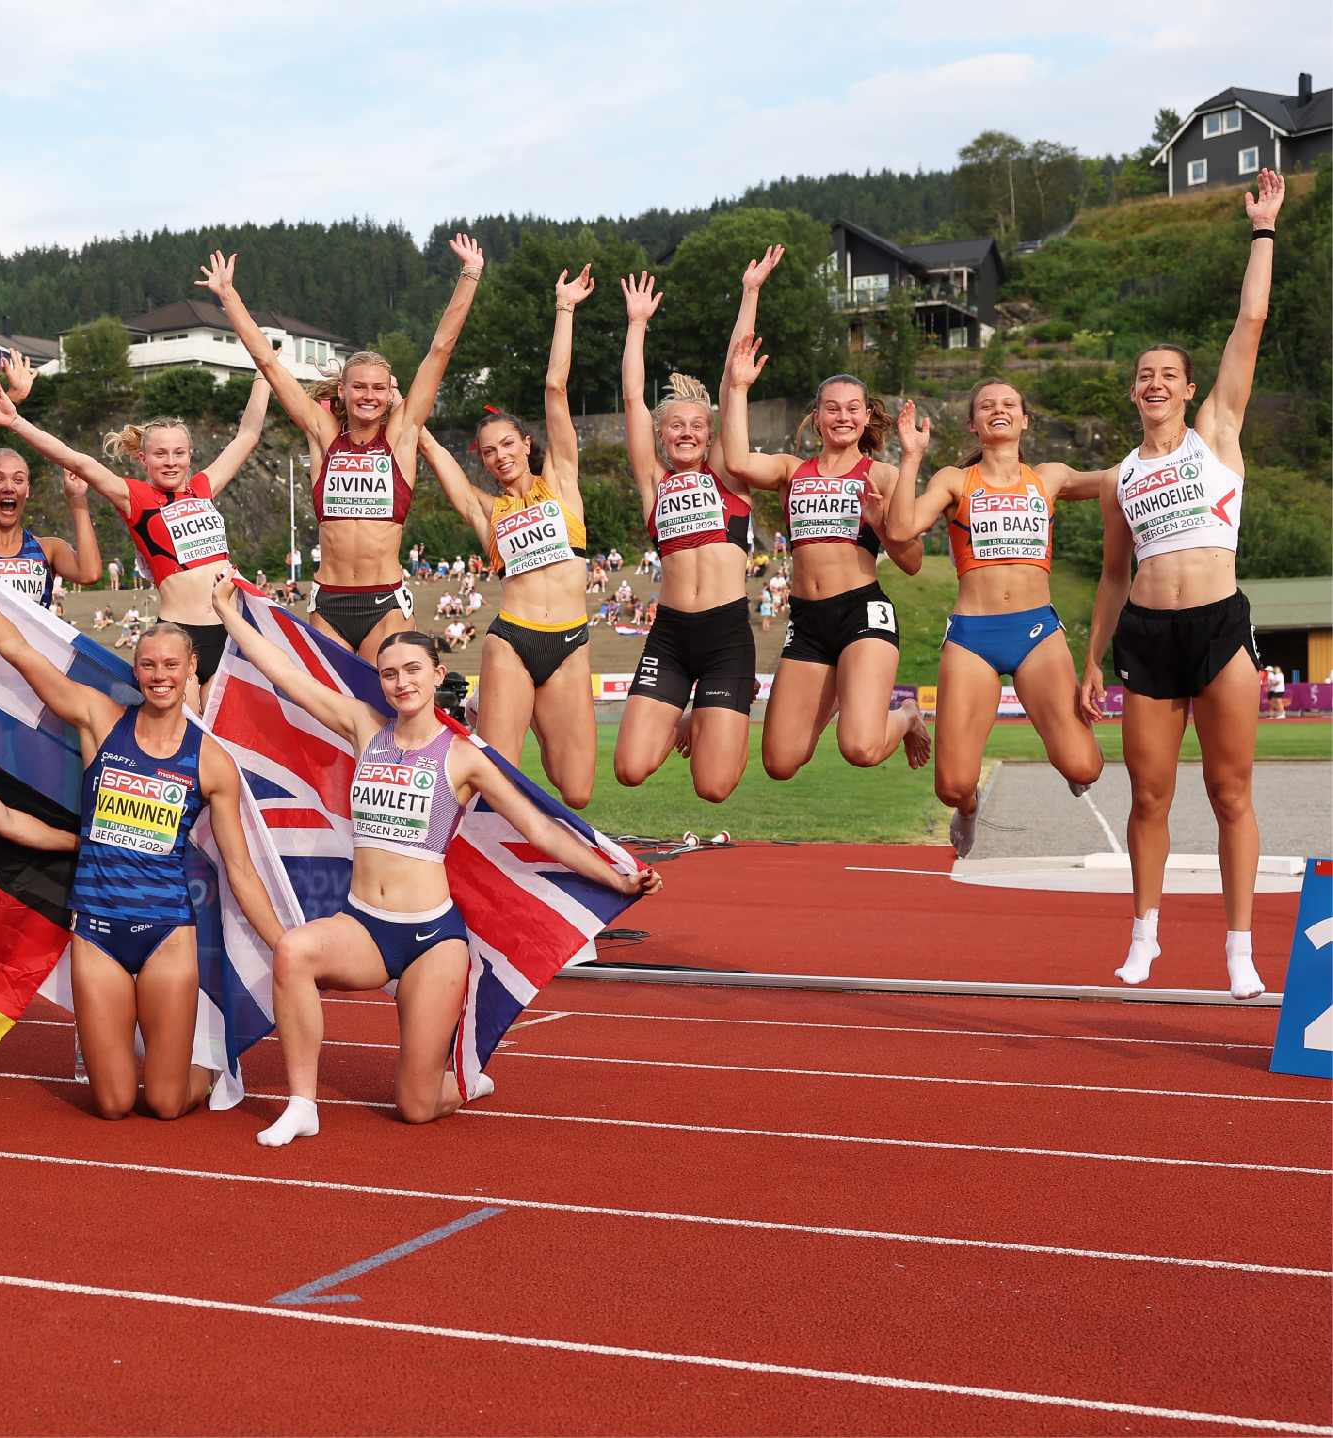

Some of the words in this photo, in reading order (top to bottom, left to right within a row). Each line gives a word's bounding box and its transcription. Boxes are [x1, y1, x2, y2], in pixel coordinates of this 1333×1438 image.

[330, 457, 373, 470] SPAR
[328, 476, 387, 493] SIVINA
[793, 480, 842, 494] SPAR
[1126, 470, 1177, 498] SPAR
[164, 500, 204, 520] SPAR
[327, 506, 363, 515] BERGEN
[364, 507, 387, 515] 2025
[657, 492, 717, 517] JENSEN
[790, 495, 859, 515] SCHÄRFE
[973, 497, 1028, 512] SPAR
[1125, 482, 1205, 522] VANHOEIJEN
[170, 516, 225, 540] BICHSEL
[496, 508, 543, 538] SPAR
[660, 524, 693, 539] BERGEN
[695, 521, 719, 530] 2025
[668, 518, 682, 526] RUN
[795, 526, 828, 537] BERGEN
[829, 526, 852, 536] 2025
[972, 520, 998, 534] van
[1002, 516, 1047, 533] BAAST
[1141, 522, 1178, 543] BERGEN
[1180, 517, 1206, 528] 2025
[1147, 518, 1164, 528] RUN
[509, 523, 556, 554] JUNG
[184, 545, 217, 560] BERGEN
[979, 546, 1020, 558] BERGEN
[1021, 547, 1042, 557] 2025
[511, 556, 547, 575] BERGEN
[547, 550, 568, 560] 2025
[402, 589, 412, 610] 5
[877, 604, 889, 625] 3
[638, 656, 659, 687] DEN
[102, 751, 130, 765] CRAFT
[157, 770, 193, 786] motonet
[359, 766, 411, 784] SPAR
[103, 772, 161, 798] SPAR
[352, 786, 431, 813] PAWLETT
[98, 793, 178, 828] VANNINEN
[110, 823, 127, 832] RUN
[356, 822, 391, 836] BERGEN
[393, 828, 420, 839] 2025
[95, 830, 137, 846] BERGEN
[139, 840, 164, 853] 2025
